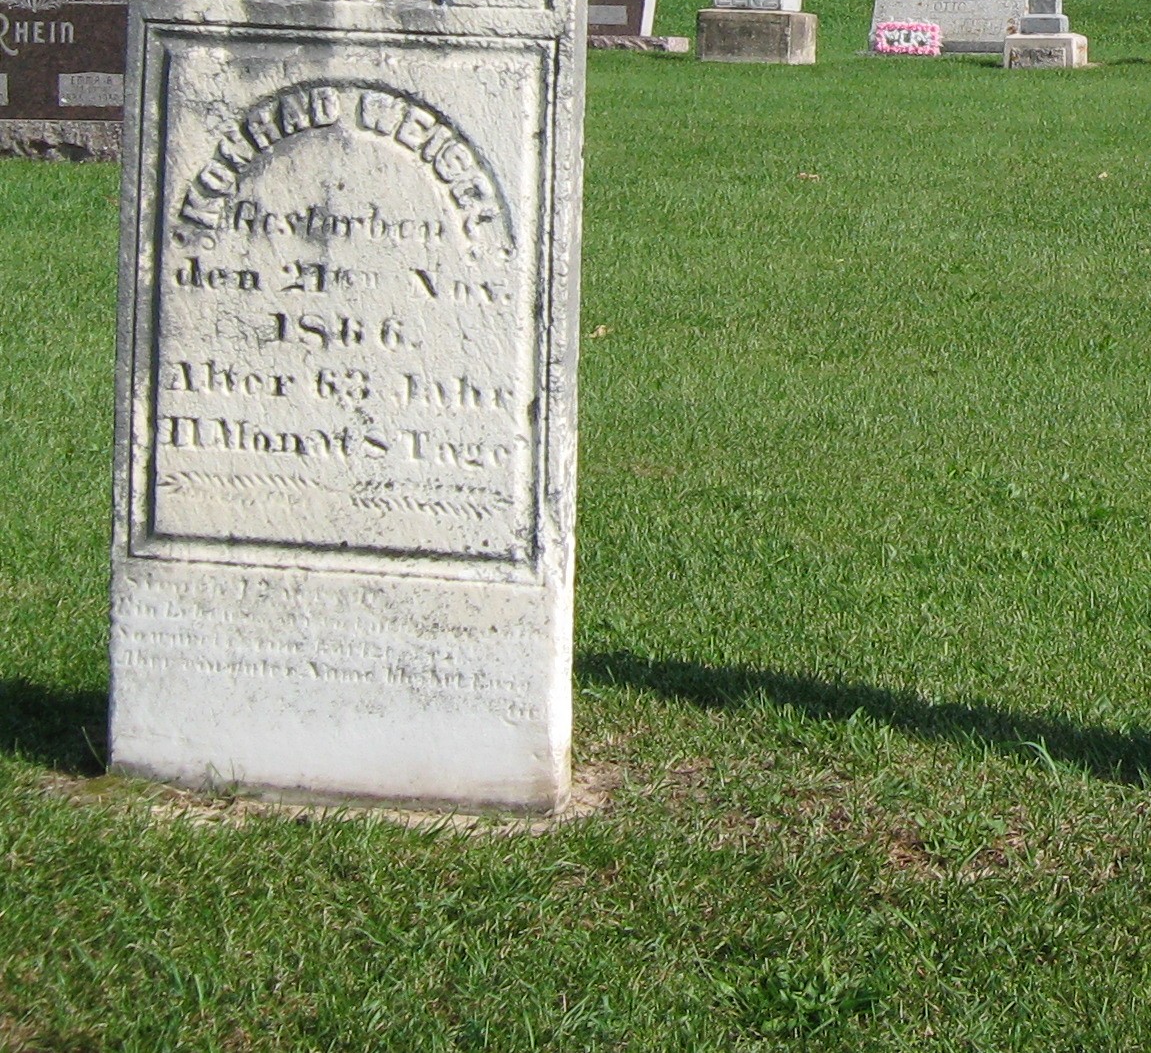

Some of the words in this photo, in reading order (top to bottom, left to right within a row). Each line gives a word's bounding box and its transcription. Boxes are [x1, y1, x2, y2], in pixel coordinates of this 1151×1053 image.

[174, 256, 262, 292] den
[164, 358, 296, 397] Alter
[397, 428, 512, 471] Tage
